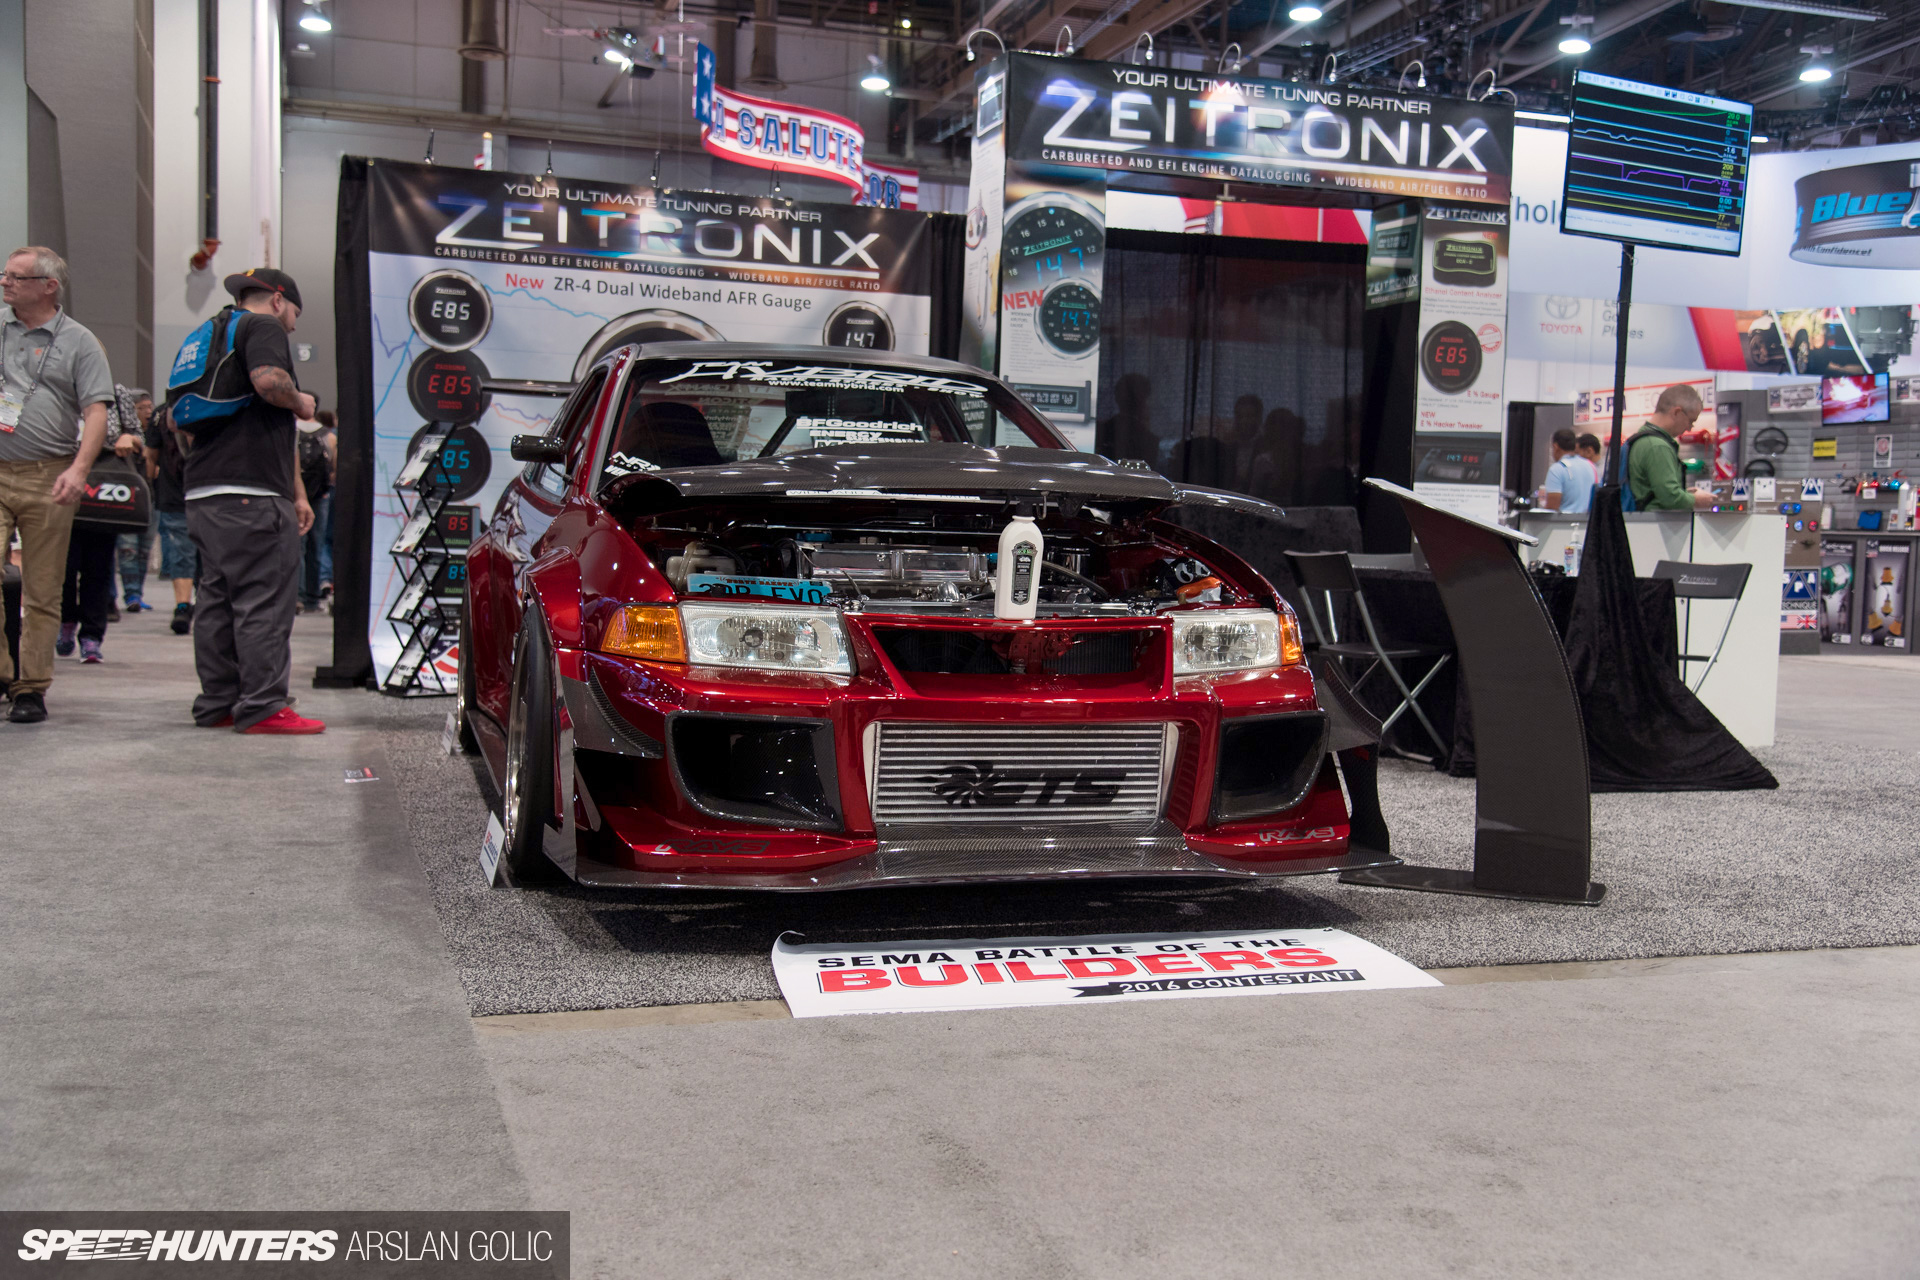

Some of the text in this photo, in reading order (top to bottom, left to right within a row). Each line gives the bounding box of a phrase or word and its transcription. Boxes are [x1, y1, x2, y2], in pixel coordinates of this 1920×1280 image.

[1113, 69, 1431, 114] YOUR ULTIMATE TUNING PARTNER
[713, 98, 857, 175] A SALUTE
[1043, 84, 1488, 173] ZEITRONIX
[1042, 149, 1488, 199] CARBURETED AND EFI ENGINE DATALOGGING WIDEBAND AIR/FUEL RATIO
[504, 183, 822, 223] YOUR ULTIMATE TUNING PARTNER
[1811, 192, 1913, 224] Blue
[1037, 219, 1065, 228] 15 14
[1426, 207, 1507, 224] ZEITRONIX
[436, 195, 881, 270] ZEITRONIX
[1020, 229, 1084, 238] 16 13
[1010, 245, 1096, 256] 17 12
[1024, 234, 1073, 256] ZEITRONIX
[434, 247, 881, 291] CARBURETED AND EFI ENGINE DATALOGGING WIDEBAND AIR/FUEL RATIO
[1009, 268, 1018, 276] 18
[506, 273, 811, 312] New ZR-4 Dual Wideband AFR Gauge
[1367, 274, 1418, 296] ZEITRONIX
[1425, 287, 1447, 295] Ethanol
[1003, 289, 1044, 311] NEW
[431, 301, 470, 320] E85
[1062, 311, 1090, 327] 14.7
[1540, 323, 1583, 335] TOYOTA
[1602, 325, 1644, 339] Ples
[845, 332, 875, 348] 14.7
[1435, 346, 1467, 364] E85
[428, 374, 472, 395] E85
[768, 380, 904, 393] www.teamhybrid.com
[961, 400, 988, 411] ULTIMATE
[796, 416, 923, 432] BFGoodrich
[964, 411, 985, 421] TUNING
[433, 450, 470, 469] 85
[447, 516, 469, 531] 85
[1678, 575, 1718, 585] ZEITRONIX
[1259, 826, 1336, 842] RAYS
[818, 938, 1306, 968] SEMA BATTLE OF THE
[817, 948, 1338, 993] BUILDERS
[1119, 969, 1356, 993] 2016 CONTESTANT
